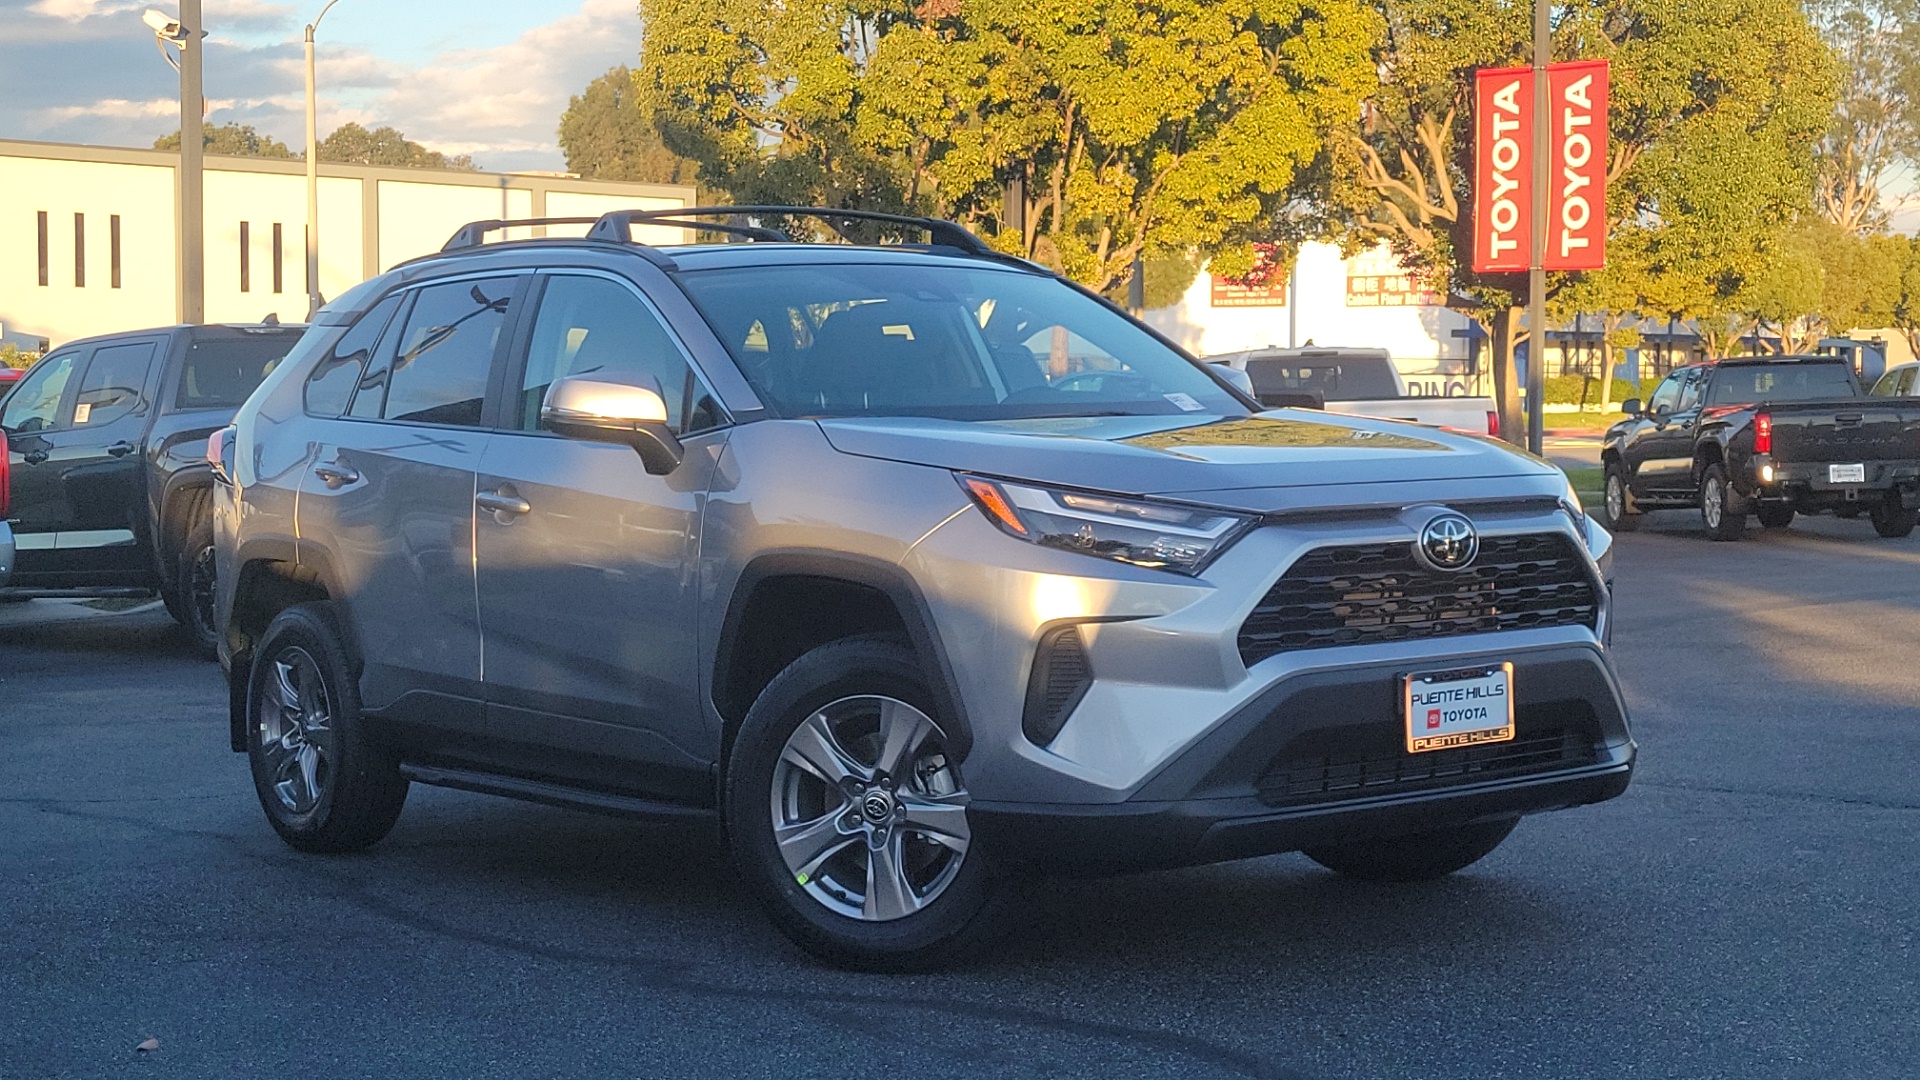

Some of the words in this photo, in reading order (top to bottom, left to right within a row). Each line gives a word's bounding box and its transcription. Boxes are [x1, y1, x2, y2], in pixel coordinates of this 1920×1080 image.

[1490, 80, 1520, 259] TOYOTA
[1561, 74, 1592, 257] TOYOTA
[1412, 688, 1464, 706] PUENTE
[1466, 684, 1504, 699] HILLS
[1443, 707, 1487, 723] TOYOTA
[1415, 734, 1469, 750] PUENTE
[1470, 728, 1508, 742] HILLS
